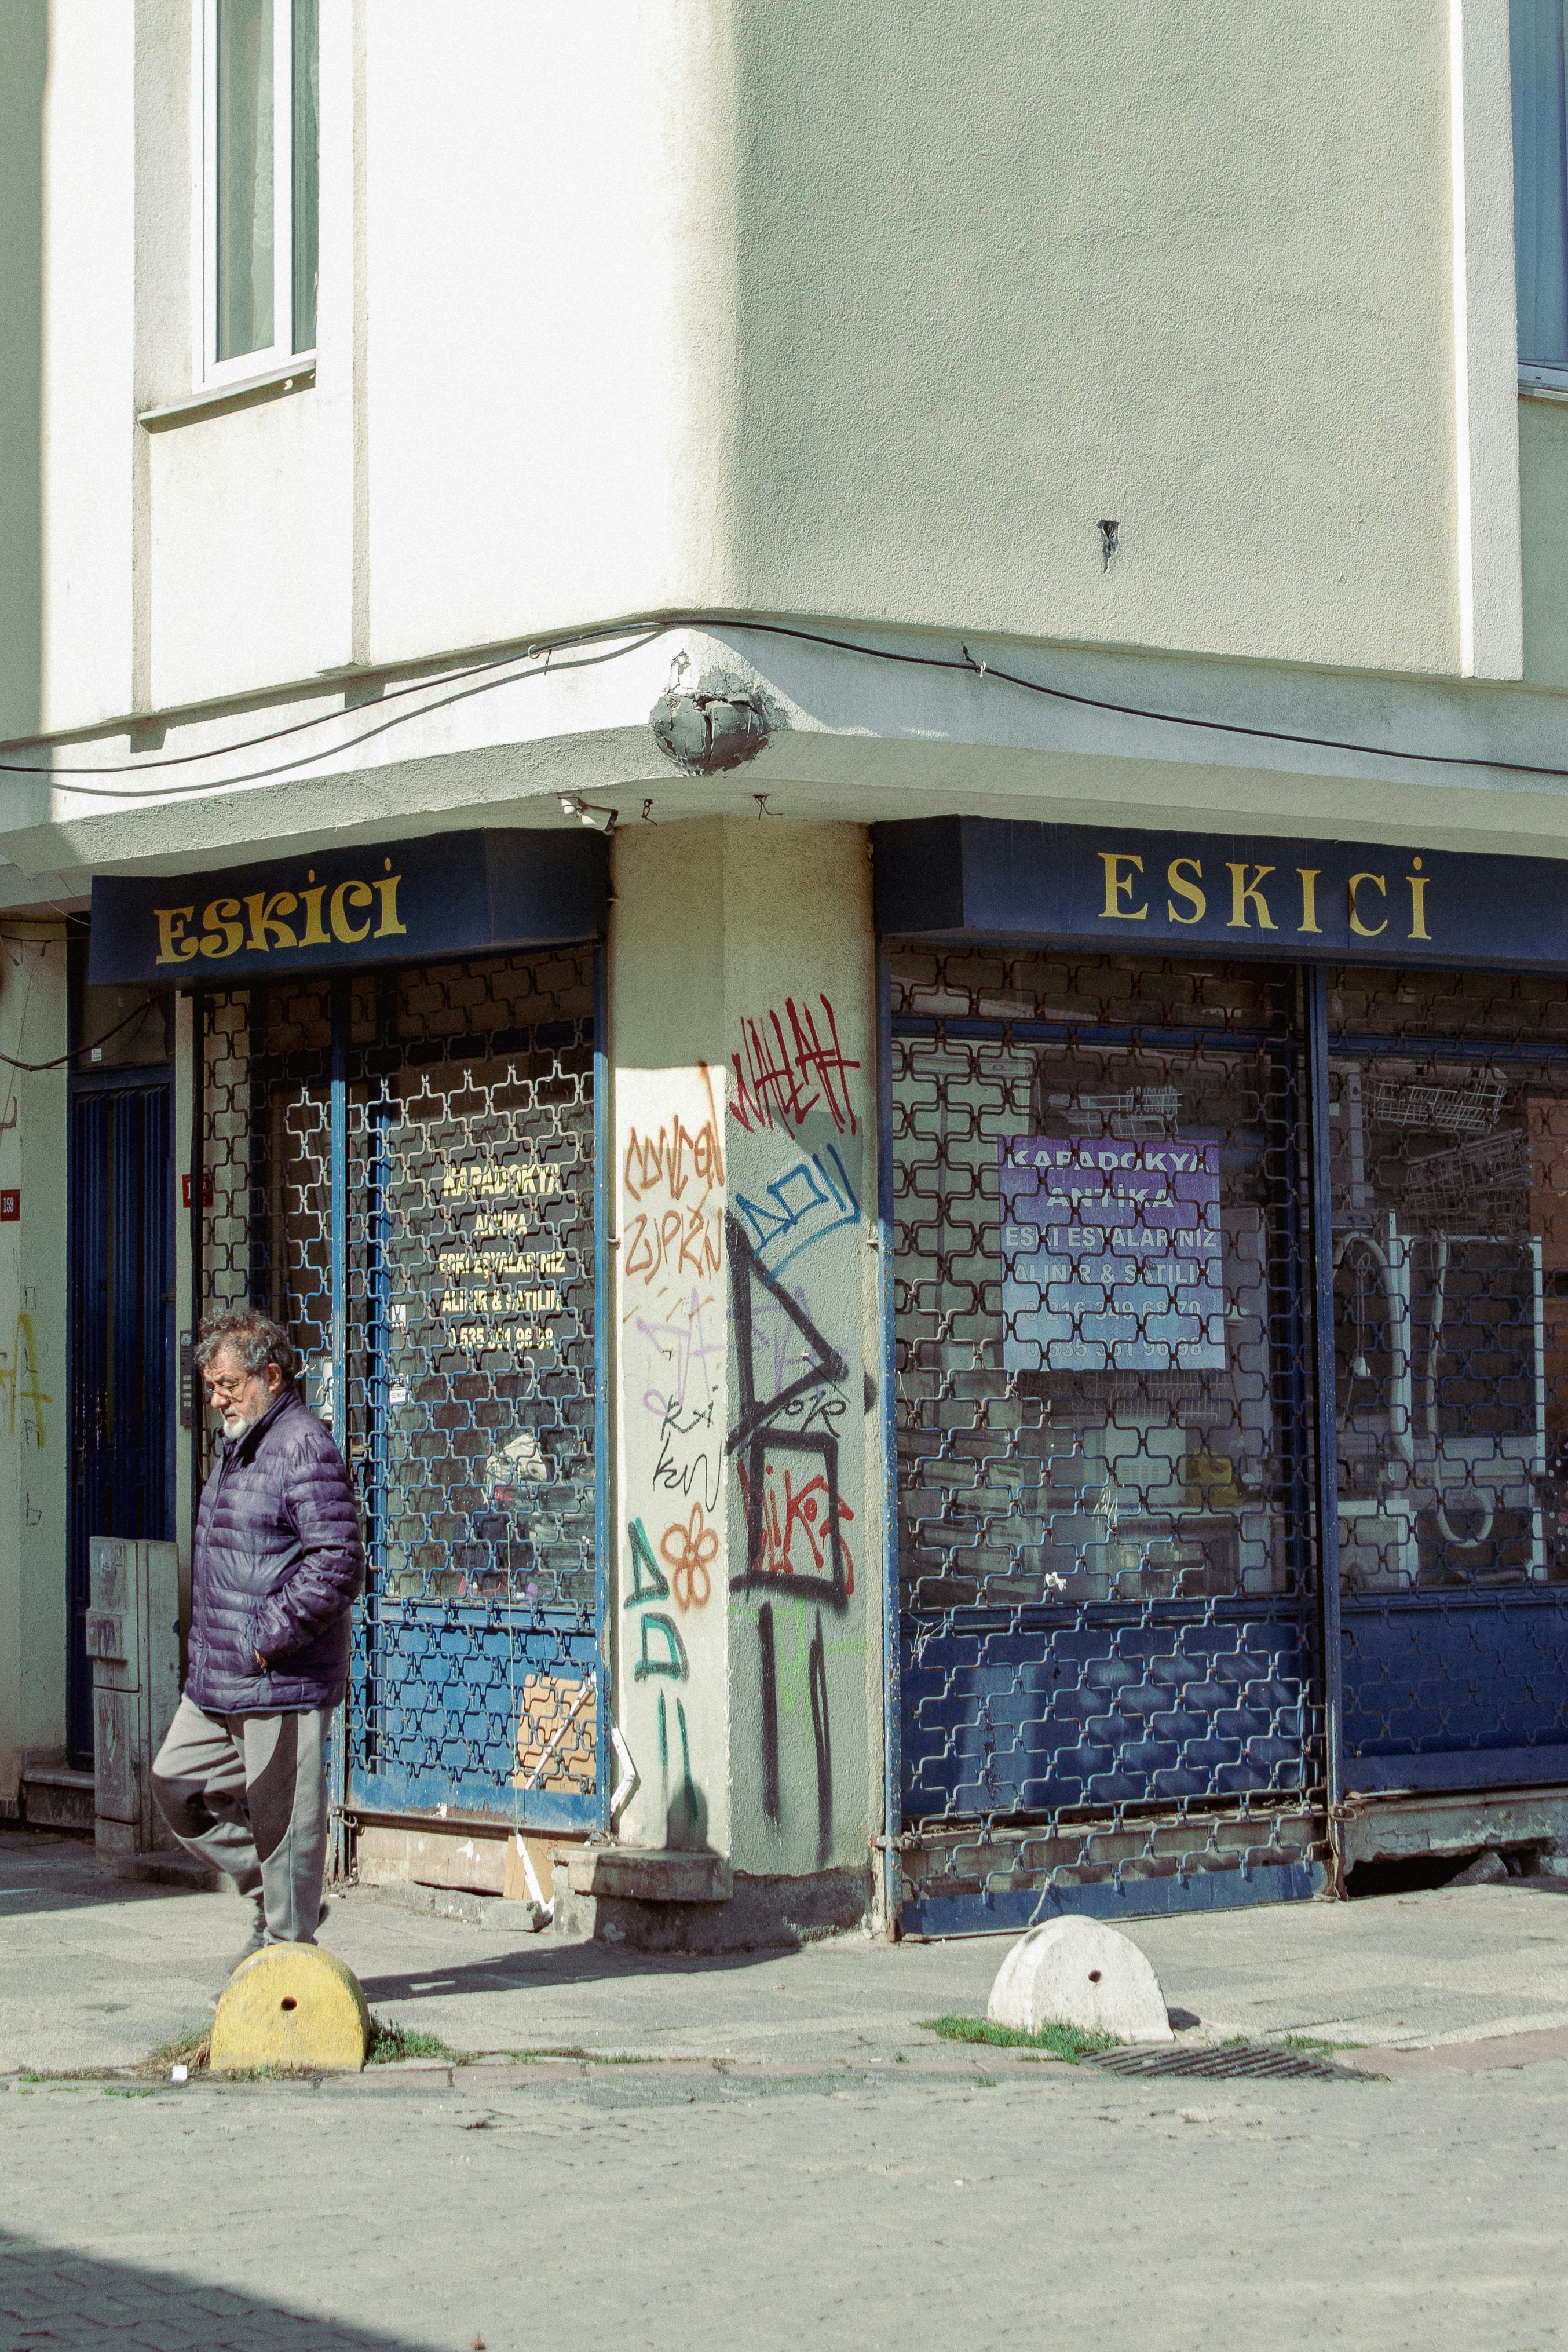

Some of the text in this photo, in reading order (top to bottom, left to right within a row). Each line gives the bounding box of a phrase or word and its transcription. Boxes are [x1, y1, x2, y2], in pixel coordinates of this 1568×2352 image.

[1006, 1149, 1211, 1172] KAPADOKYA
[444, 1163, 559, 1197] KAPADOKYA
[3, 1197, 14, 1214] 159
[1046, 1184, 1174, 1208] ANTİKA
[473, 1209, 528, 1236] ANTİKA
[474, 1251, 565, 1279] EŞYALARNIZ
[1014, 1263, 1092, 1283] ALINR
[1100, 1263, 1116, 1284] &
[491, 1290, 502, 1312] &
[1046, 1300, 1087, 1321] 216
[1094, 1299, 1135, 1321] 349
[1176, 1299, 1201, 1321] 70
[460, 1327, 485, 1349] 535
[1048, 1338, 1088, 1358] 535
